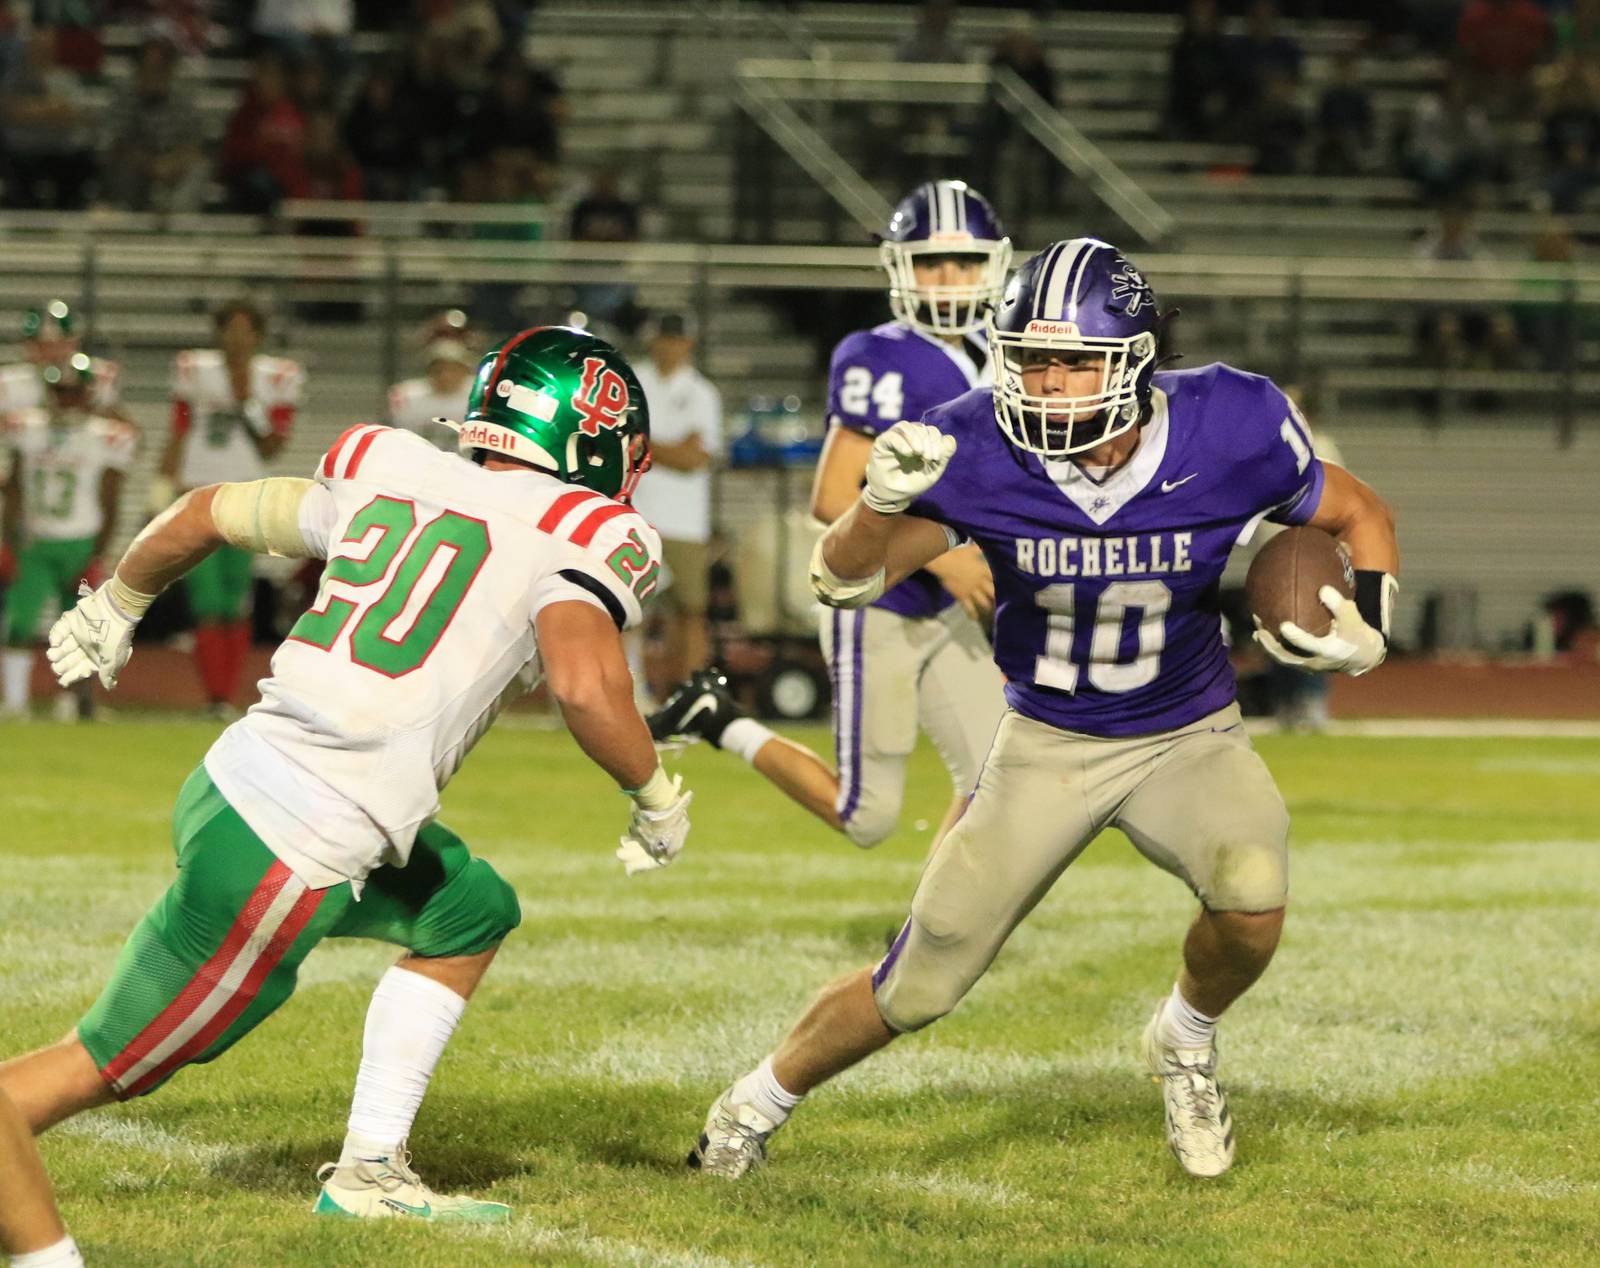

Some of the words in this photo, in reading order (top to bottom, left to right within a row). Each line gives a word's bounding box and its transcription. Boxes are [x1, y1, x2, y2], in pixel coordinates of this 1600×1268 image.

[1030, 322, 1072, 334] Riddell
[841, 366, 904, 419] 24
[1015, 532, 1192, 577] ROCHELLE
[287, 494, 492, 679] 20
[1034, 579, 1172, 697] 10
